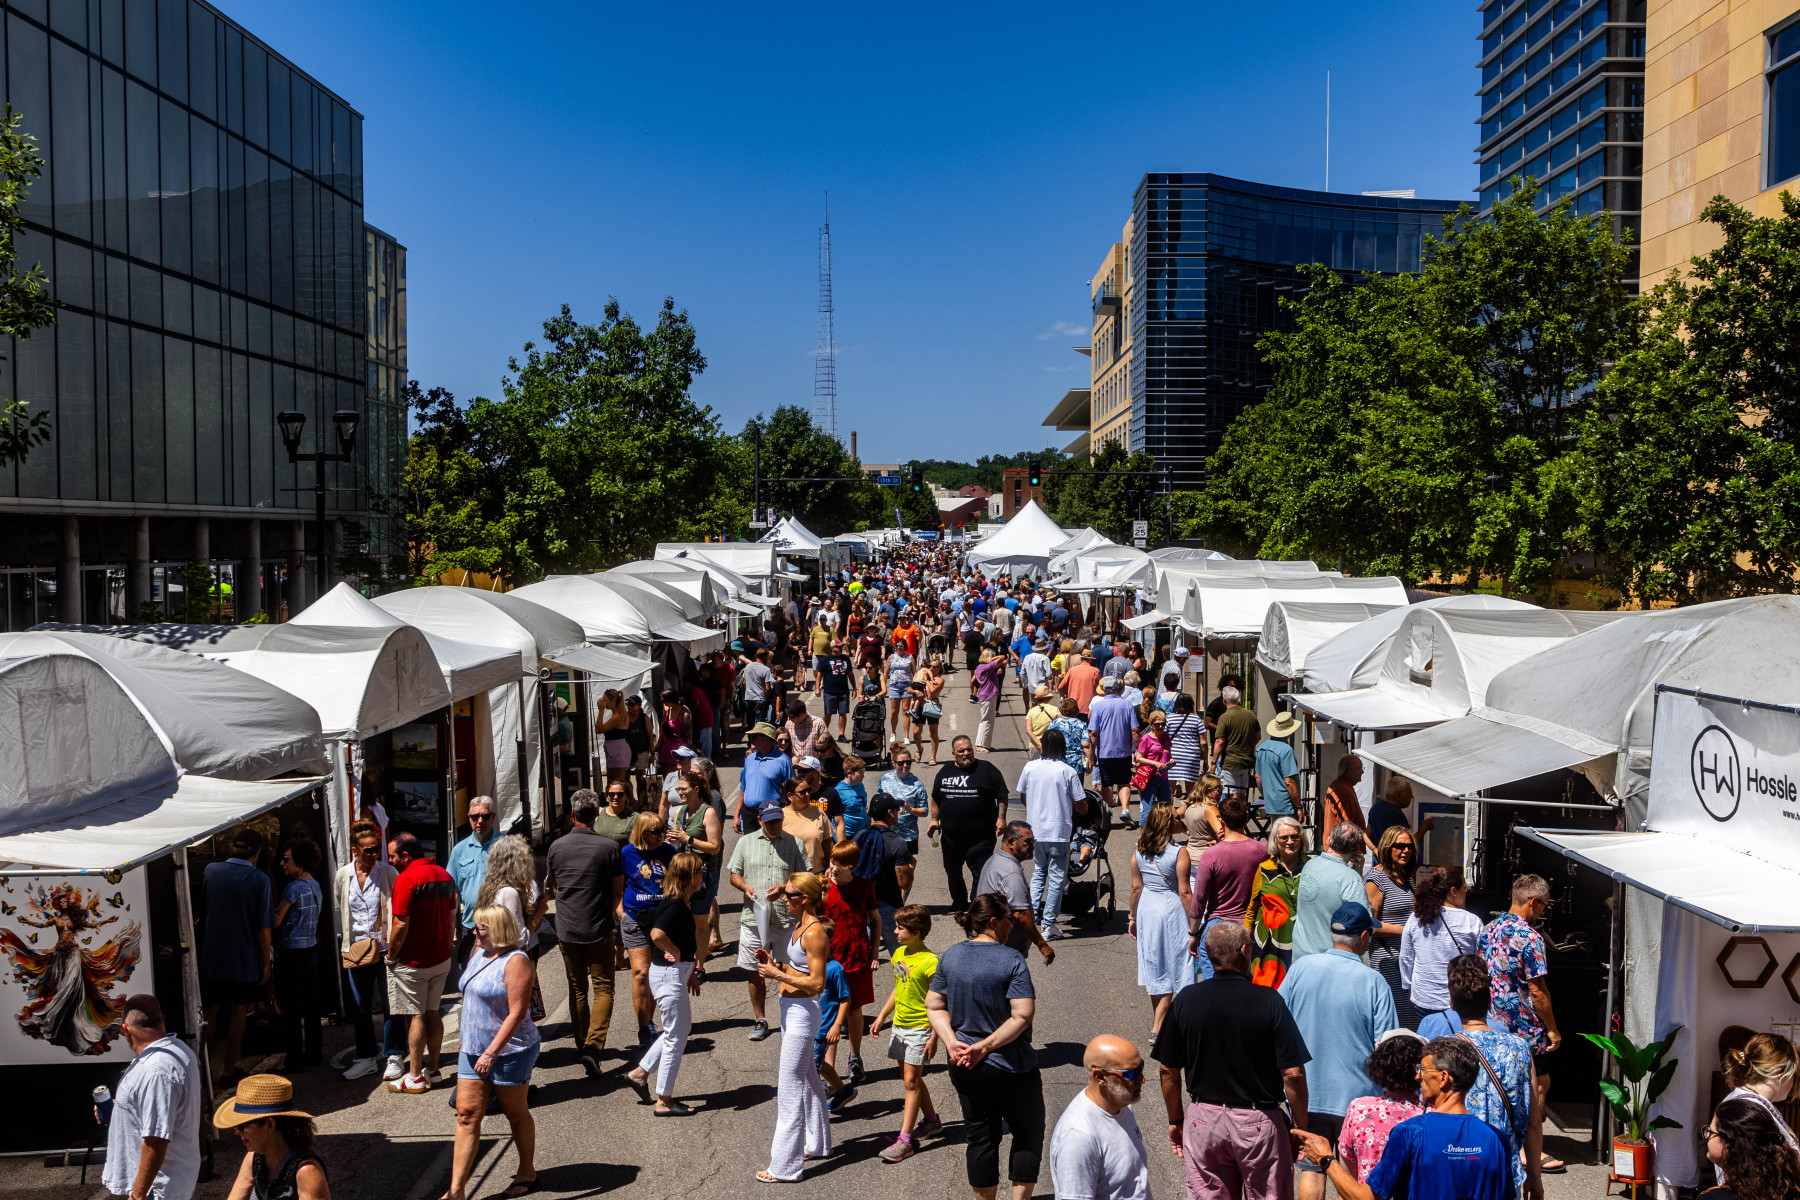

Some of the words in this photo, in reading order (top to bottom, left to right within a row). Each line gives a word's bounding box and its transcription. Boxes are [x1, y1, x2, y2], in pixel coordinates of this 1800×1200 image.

[1699, 750, 1735, 797] HW
[1747, 766, 1797, 803] Hossle
[1447, 1143, 1465, 1153] Drake
